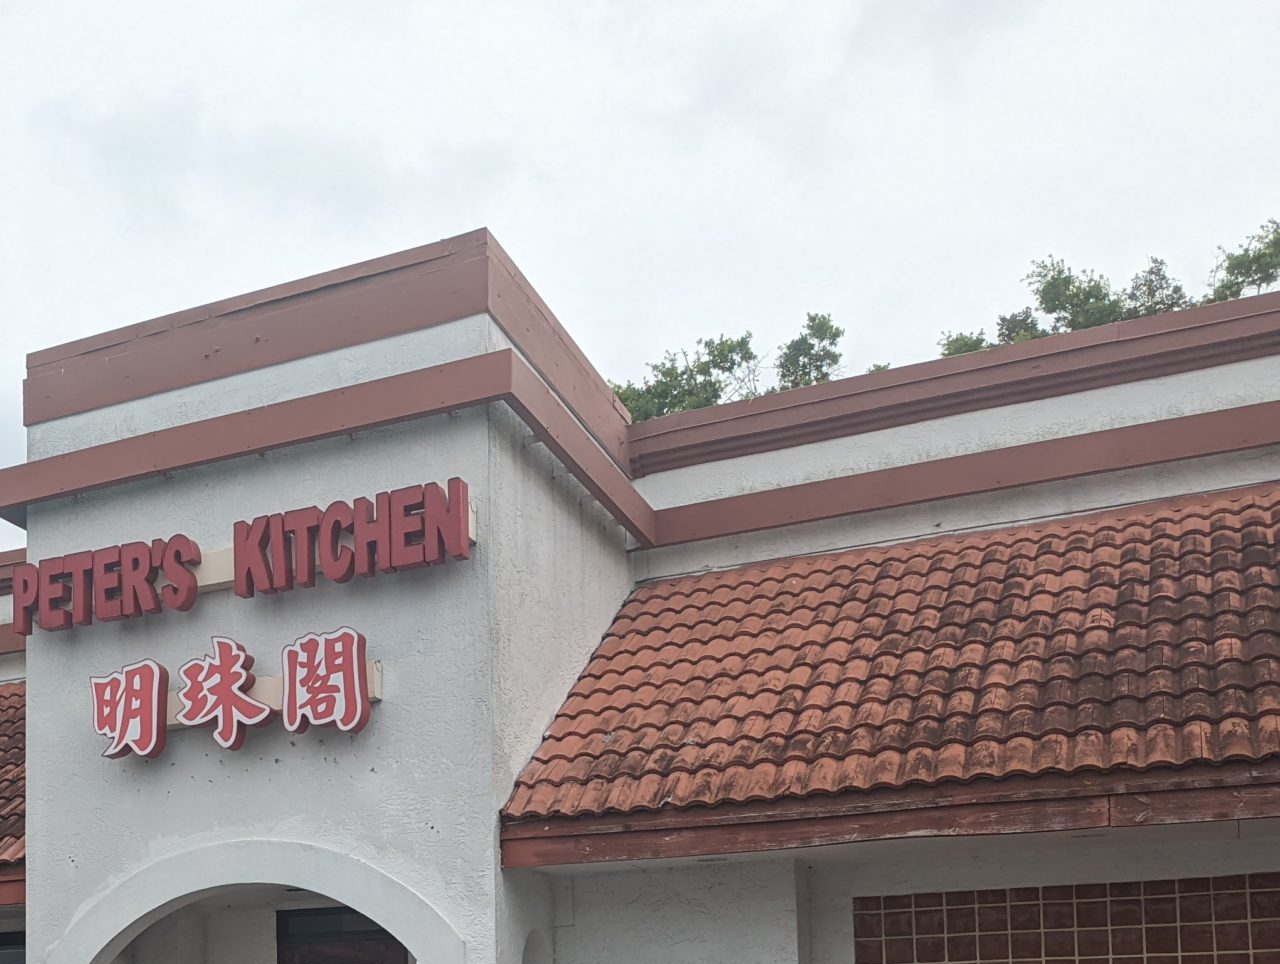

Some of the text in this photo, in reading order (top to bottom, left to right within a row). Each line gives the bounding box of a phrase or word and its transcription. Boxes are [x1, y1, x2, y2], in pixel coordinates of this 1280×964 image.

[12, 476, 470, 637] PETER'S KITCHEN
[90, 625, 371, 760] 明珠閣
